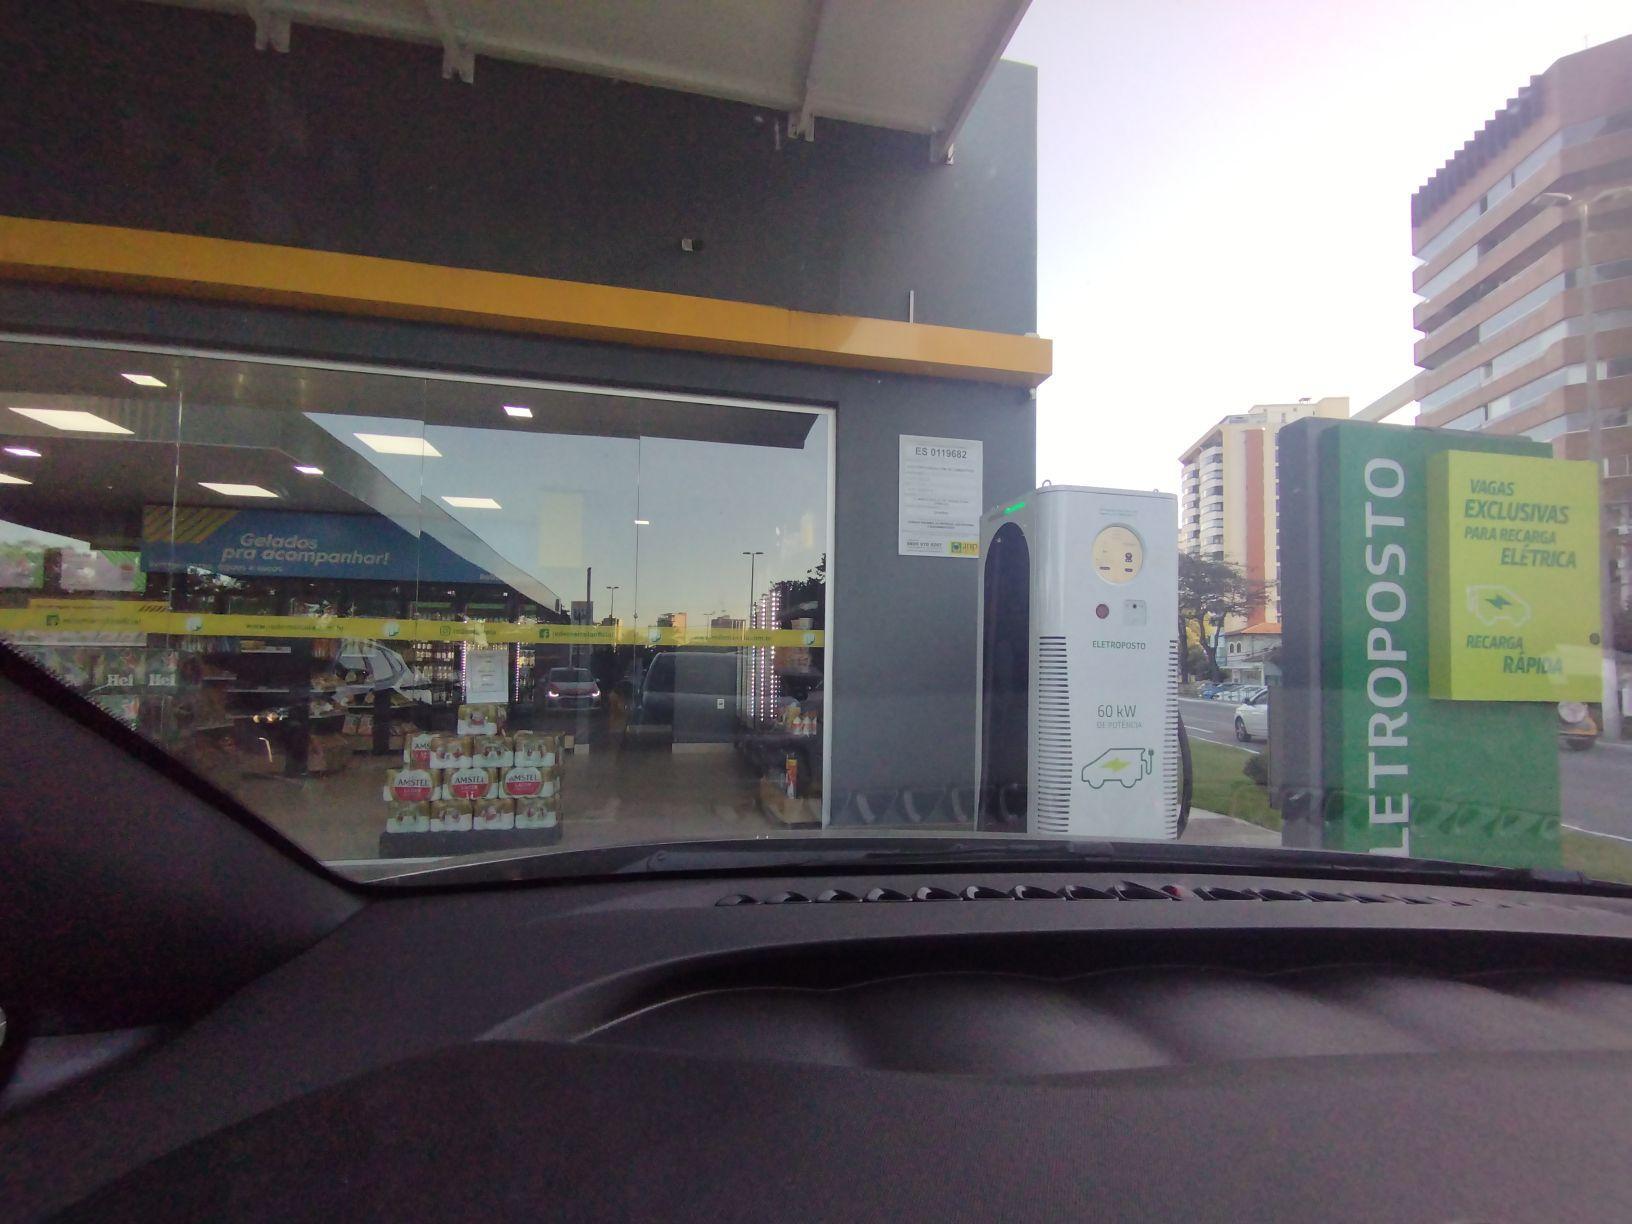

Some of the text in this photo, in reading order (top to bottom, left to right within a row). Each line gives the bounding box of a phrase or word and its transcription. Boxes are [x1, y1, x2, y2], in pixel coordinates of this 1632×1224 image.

[915, 446, 967, 459] ES 0119682
[1470, 479, 1515, 497] VAGAS
[1464, 499, 1570, 524] EXCLUSIVAS
[240, 532, 318, 550] Gelados
[1464, 526, 1557, 545] PARA RECARGA
[221, 547, 391, 567] pra acompanhar!
[1500, 544, 1577, 569] ELÉTRICA
[1092, 640, 1146, 650] ELETROPOSTO
[1466, 634, 1524, 650] RECARGA
[1364, 457, 1410, 857] LETROPOSTO
[1503, 651, 1562, 674] RÁPIDA
[1097, 704, 1137, 718] 60 kW
[398, 778, 429, 787] AMSTEL
[455, 776, 485, 785] AMSTEL
[508, 774, 538, 783] AMSTEL
